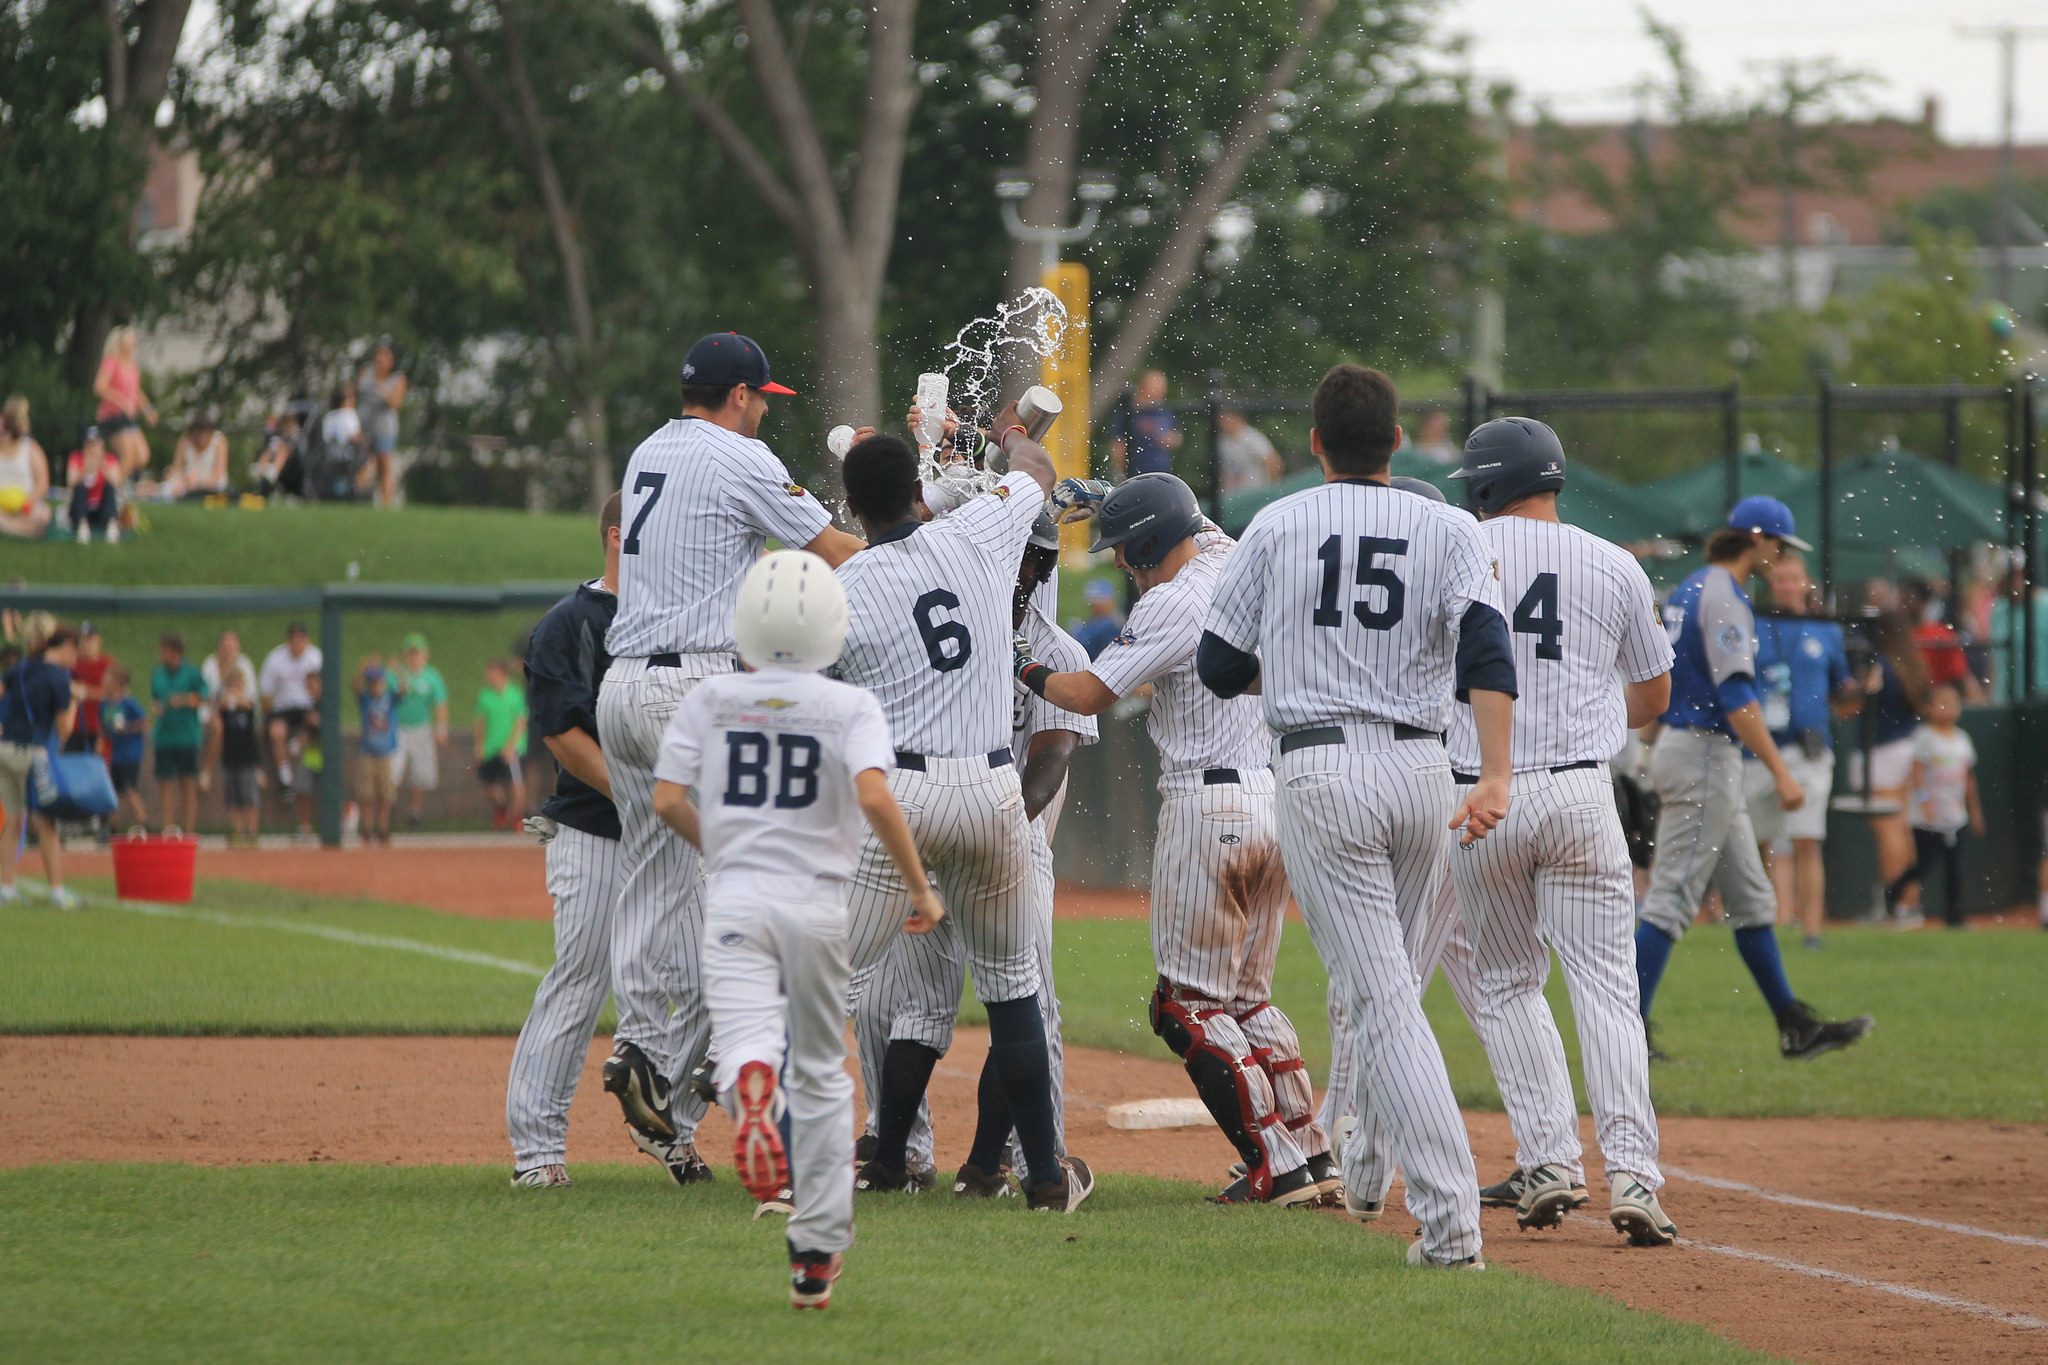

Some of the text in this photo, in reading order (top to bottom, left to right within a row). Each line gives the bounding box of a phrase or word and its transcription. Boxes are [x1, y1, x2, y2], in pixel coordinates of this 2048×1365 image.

[623, 471, 667, 555] 7
[1313, 534, 1409, 631] 15
[1512, 572, 1563, 661] 4
[912, 587, 972, 674] 6
[723, 731, 820, 809] BB
